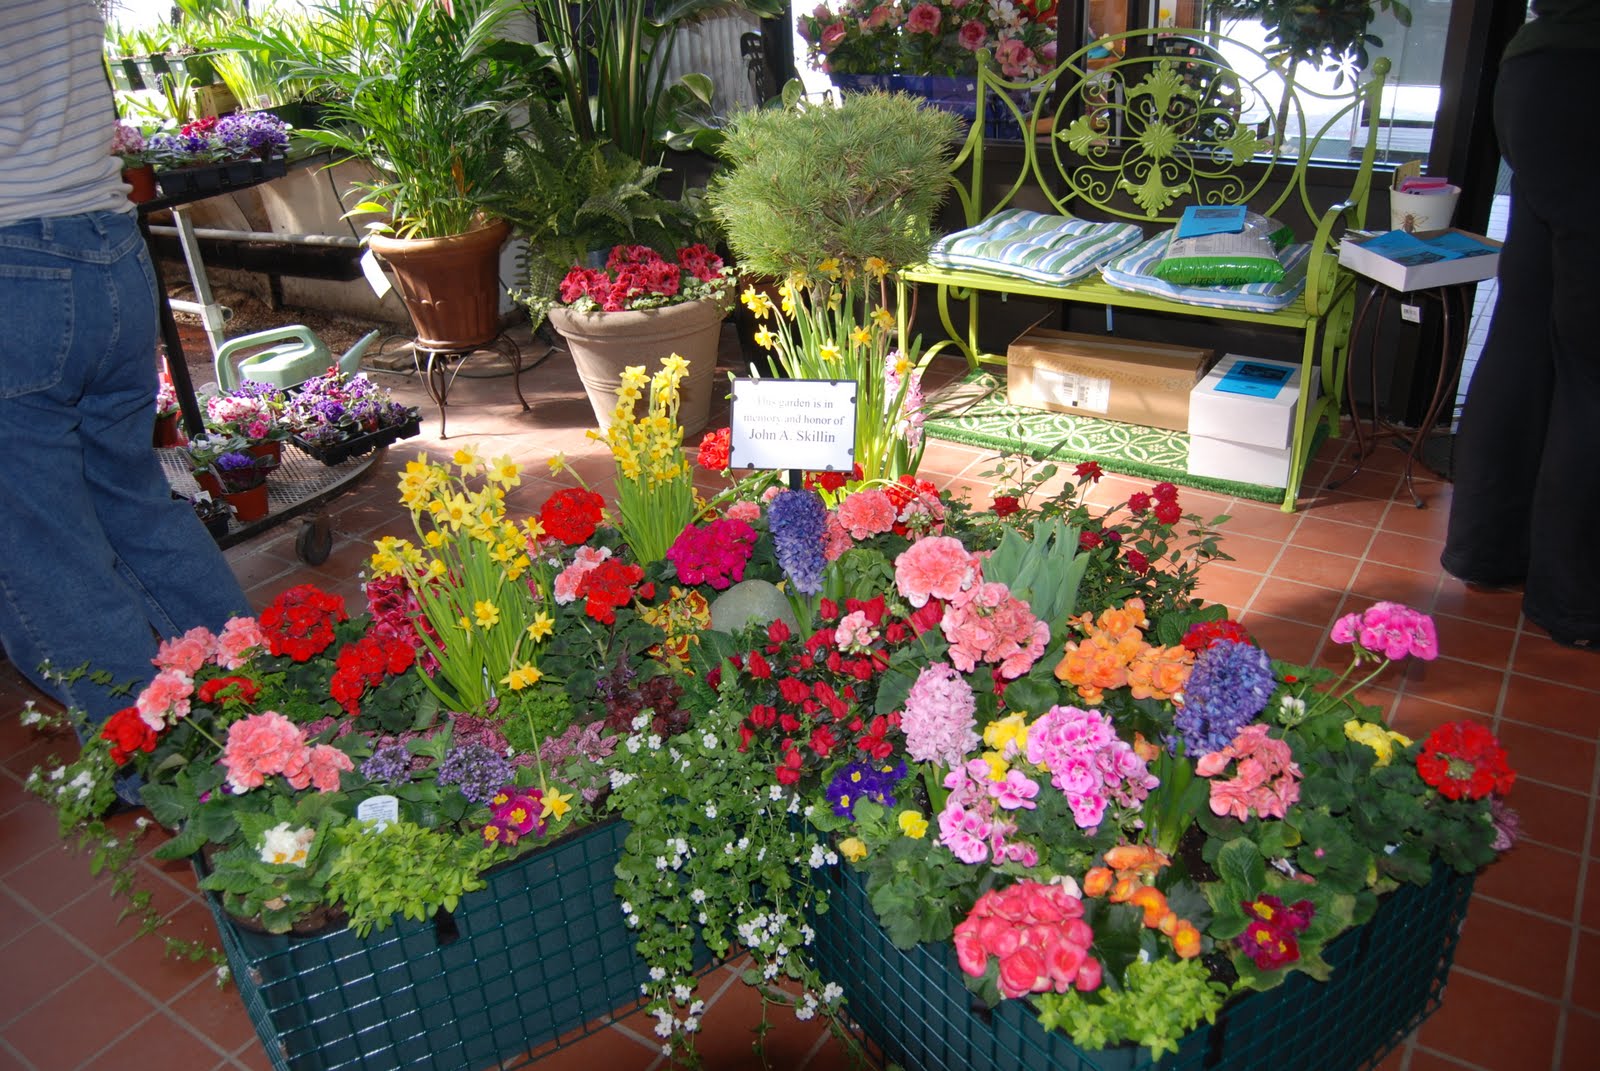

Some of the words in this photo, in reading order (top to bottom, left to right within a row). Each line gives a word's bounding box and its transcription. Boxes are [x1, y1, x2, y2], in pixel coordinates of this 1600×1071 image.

[756, 395, 776, 406] This
[778, 398, 811, 409] garden
[813, 399, 822, 408] is
[824, 399, 834, 409] in
[743, 414, 781, 425] memory
[784, 414, 801, 424] and
[803, 414, 832, 425] honor
[833, 415, 845, 426] of
[749, 428, 776, 440] John
[779, 429, 793, 441] A.
[796, 429, 836, 443] Skillin
